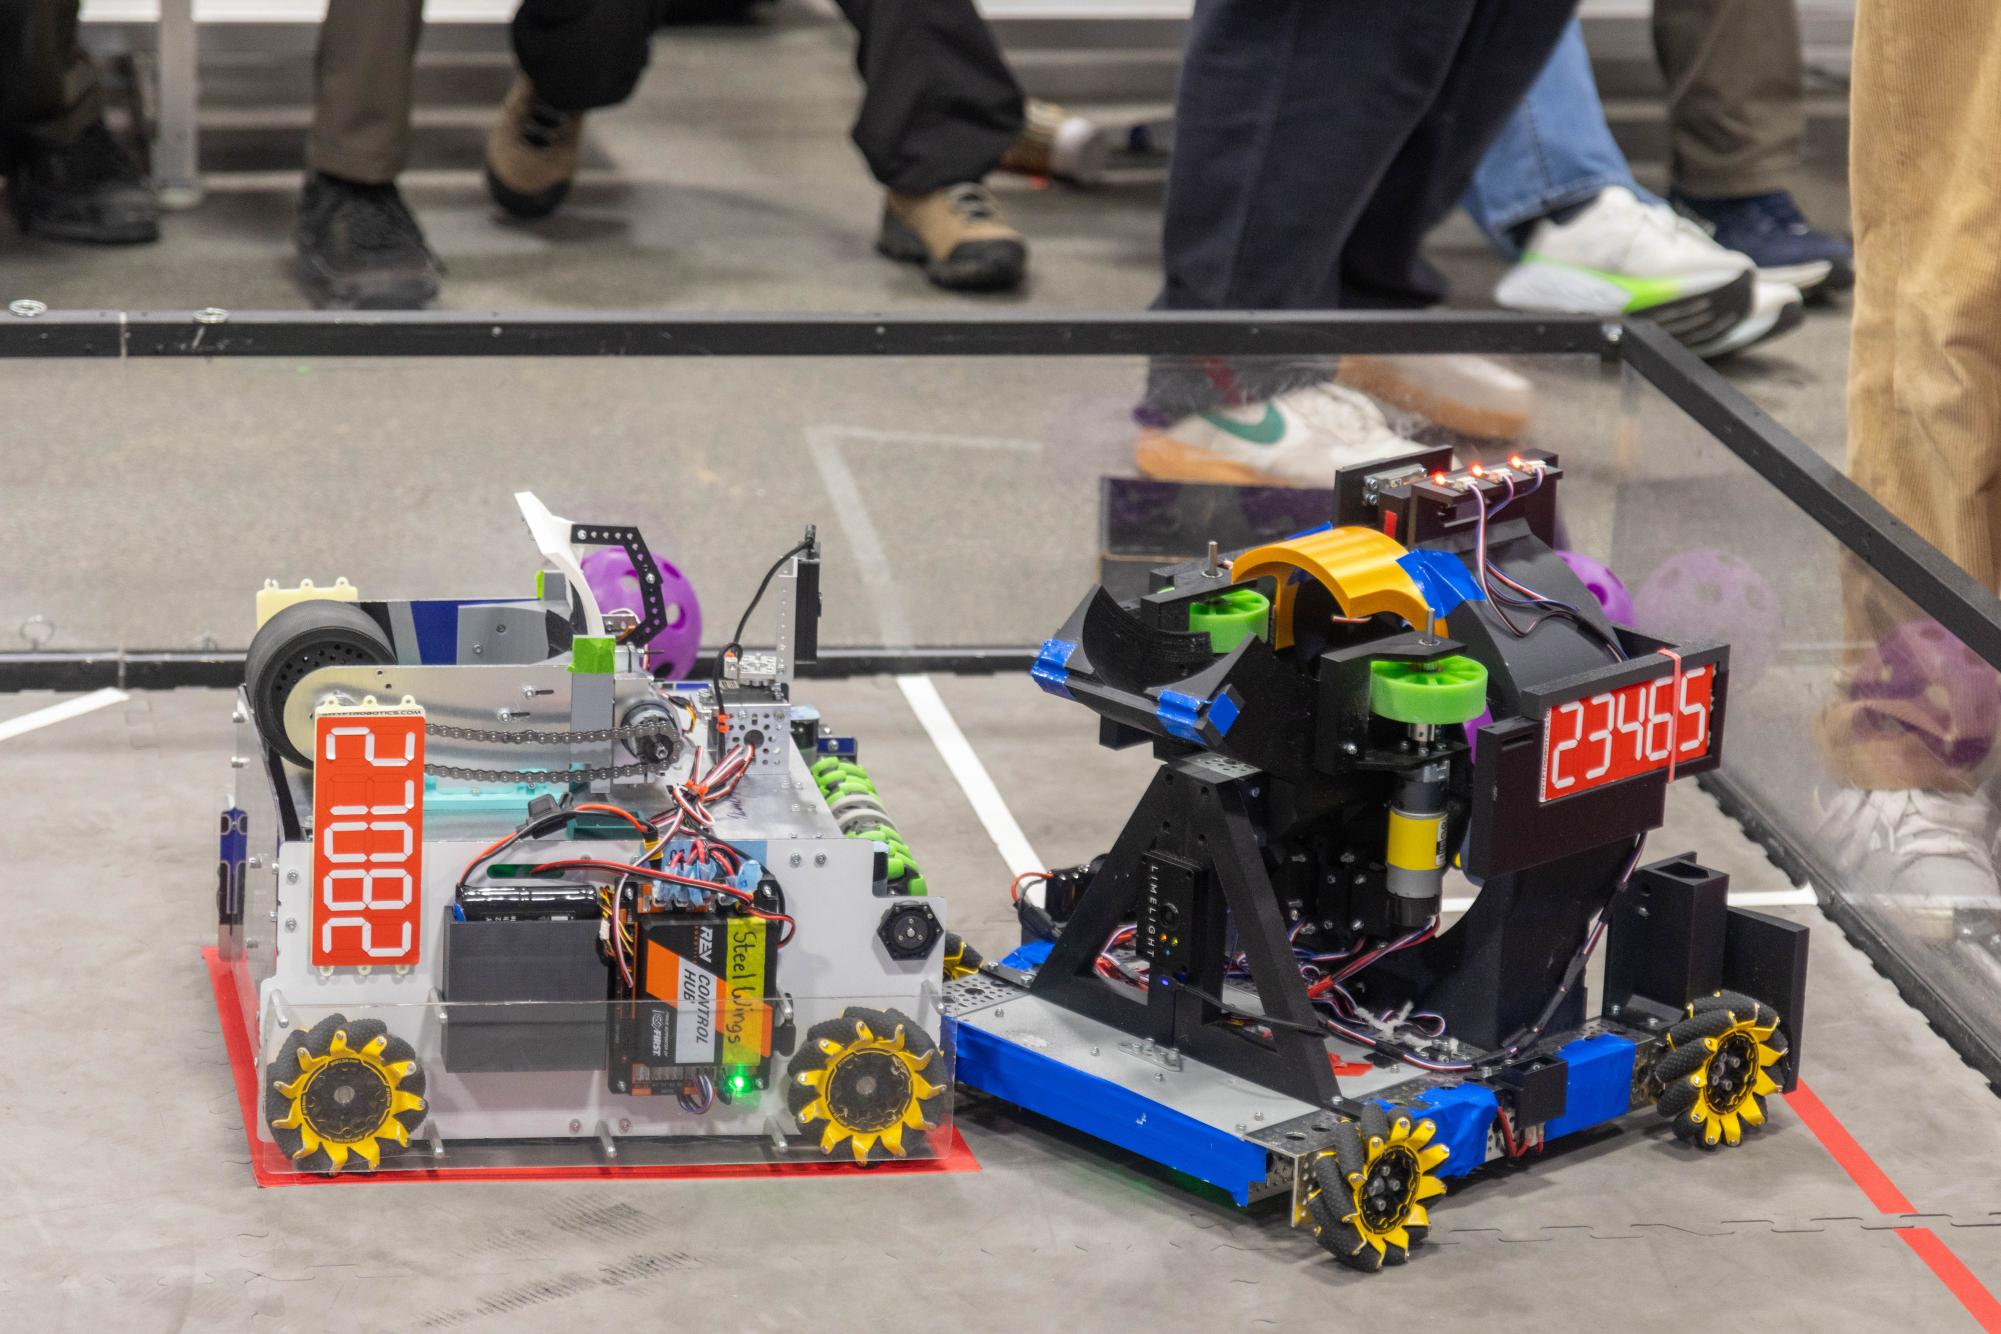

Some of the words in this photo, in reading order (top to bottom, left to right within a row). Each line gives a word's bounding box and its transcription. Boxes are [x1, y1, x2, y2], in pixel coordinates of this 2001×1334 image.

[1551, 667, 1706, 789] 23465
[323, 726, 416, 957] 27082
[1146, 864, 1159, 957] LIMELIGHT
[698, 926, 713, 963] REV
[732, 931, 757, 980] Steel
[683, 968, 696, 1002] HUB
[696, 974, 711, 1044] CONTROL
[725, 986, 756, 1044] Wings
